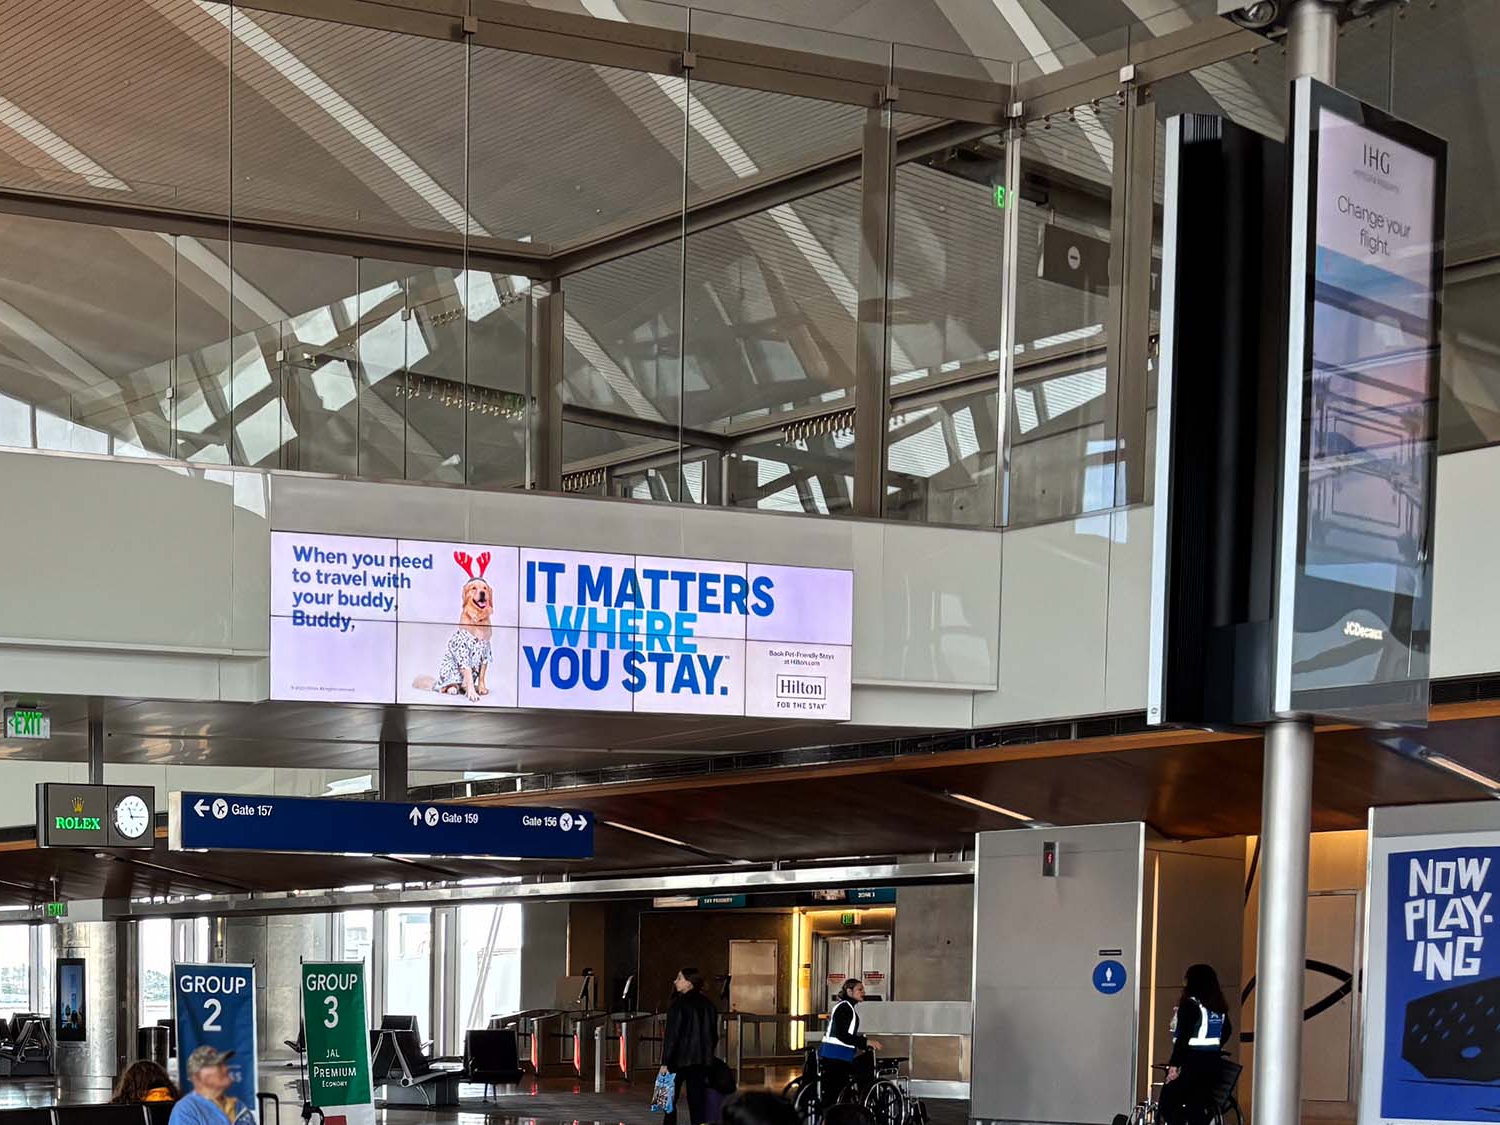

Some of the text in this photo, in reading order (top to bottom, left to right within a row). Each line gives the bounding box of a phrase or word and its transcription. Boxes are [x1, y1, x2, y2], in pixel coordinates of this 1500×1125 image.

[1363, 144, 1390, 174] IHG
[1338, 195, 1411, 238] Change your
[1359, 229, 1390, 256] flight.
[292, 545, 433, 570] When you need
[292, 568, 411, 589] to travel with
[526, 561, 775, 617] IT MATTERS
[291, 591, 399, 613] your buddy,
[292, 610, 355, 633] Buddy,
[545, 604, 698, 654] WHERE
[522, 645, 610, 691] YOU
[781, 679, 822, 696] Hilton
[777, 701, 791, 709] FOR
[793, 702, 806, 710] THE
[14, 711, 43, 736] EXIT
[231, 803, 273, 817] Gate 157
[442, 811, 479, 824] Gate 159
[55, 816, 101, 831] ROLEX
[522, 815, 557, 828] Gate 156
[1408, 857, 1492, 896] NOW
[48, 903, 63, 917] EXIT
[1412, 936, 1484, 982] ING
[180, 974, 247, 994] GROUP
[306, 973, 358, 992] GROUP
[202, 998, 222, 1032] 2
[323, 995, 339, 1029] 3
[326, 1049, 340, 1059] JAL
[313, 1065, 357, 1078] PREMIUM
